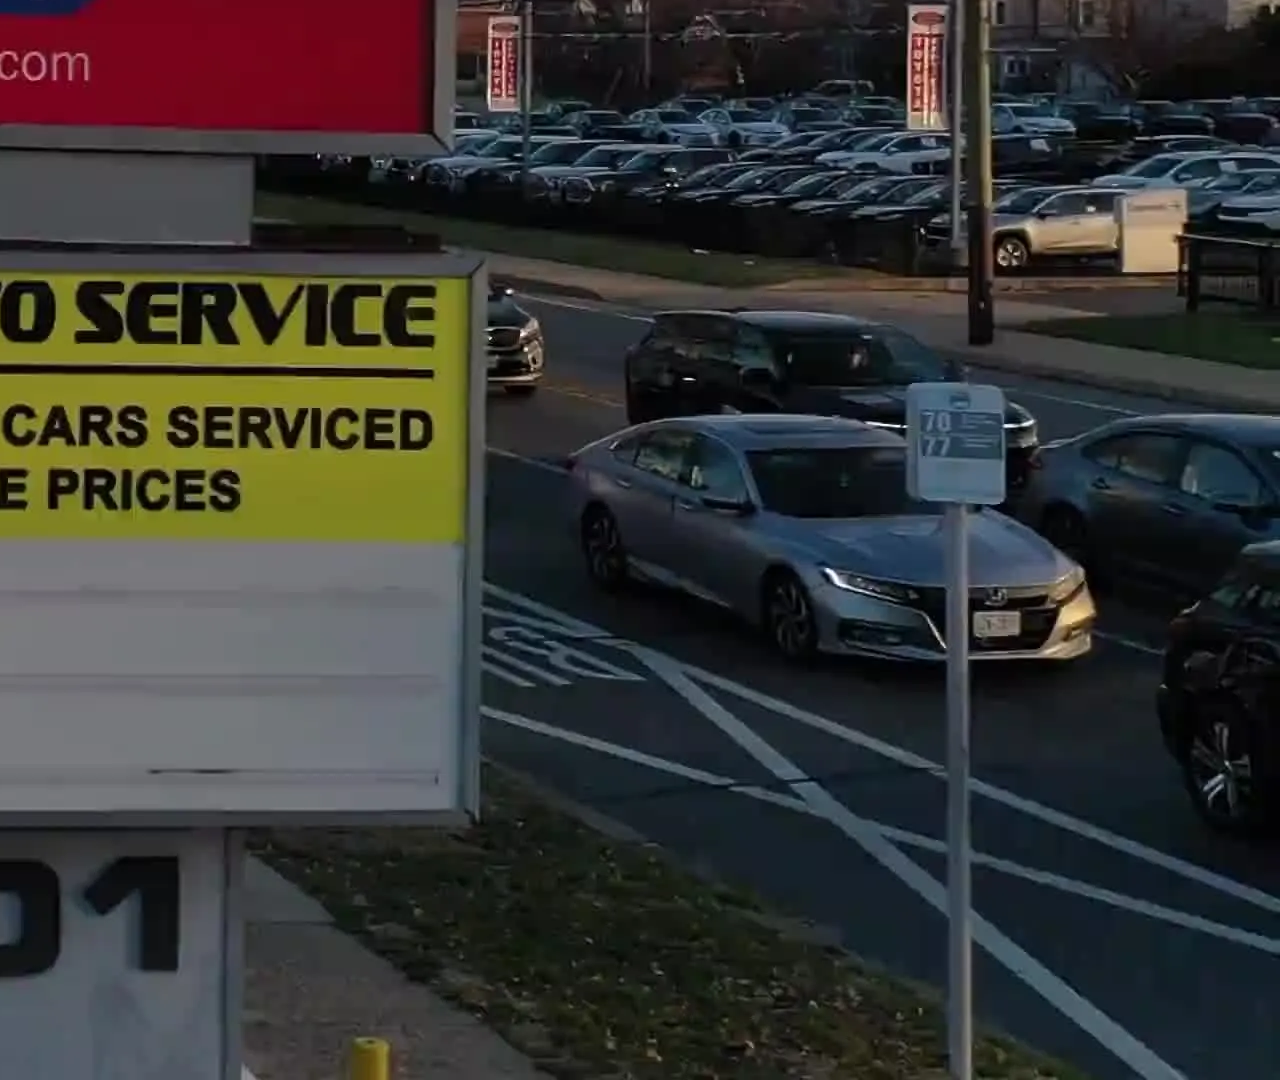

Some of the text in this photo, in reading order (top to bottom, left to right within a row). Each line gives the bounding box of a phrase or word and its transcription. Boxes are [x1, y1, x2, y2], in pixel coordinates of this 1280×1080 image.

[74, 280, 437, 349] SERVICE
[1, 405, 149, 448] CARS
[165, 407, 434, 451] SERVICED
[922, 435, 951, 457] 77
[46, 468, 242, 513] PRICES
